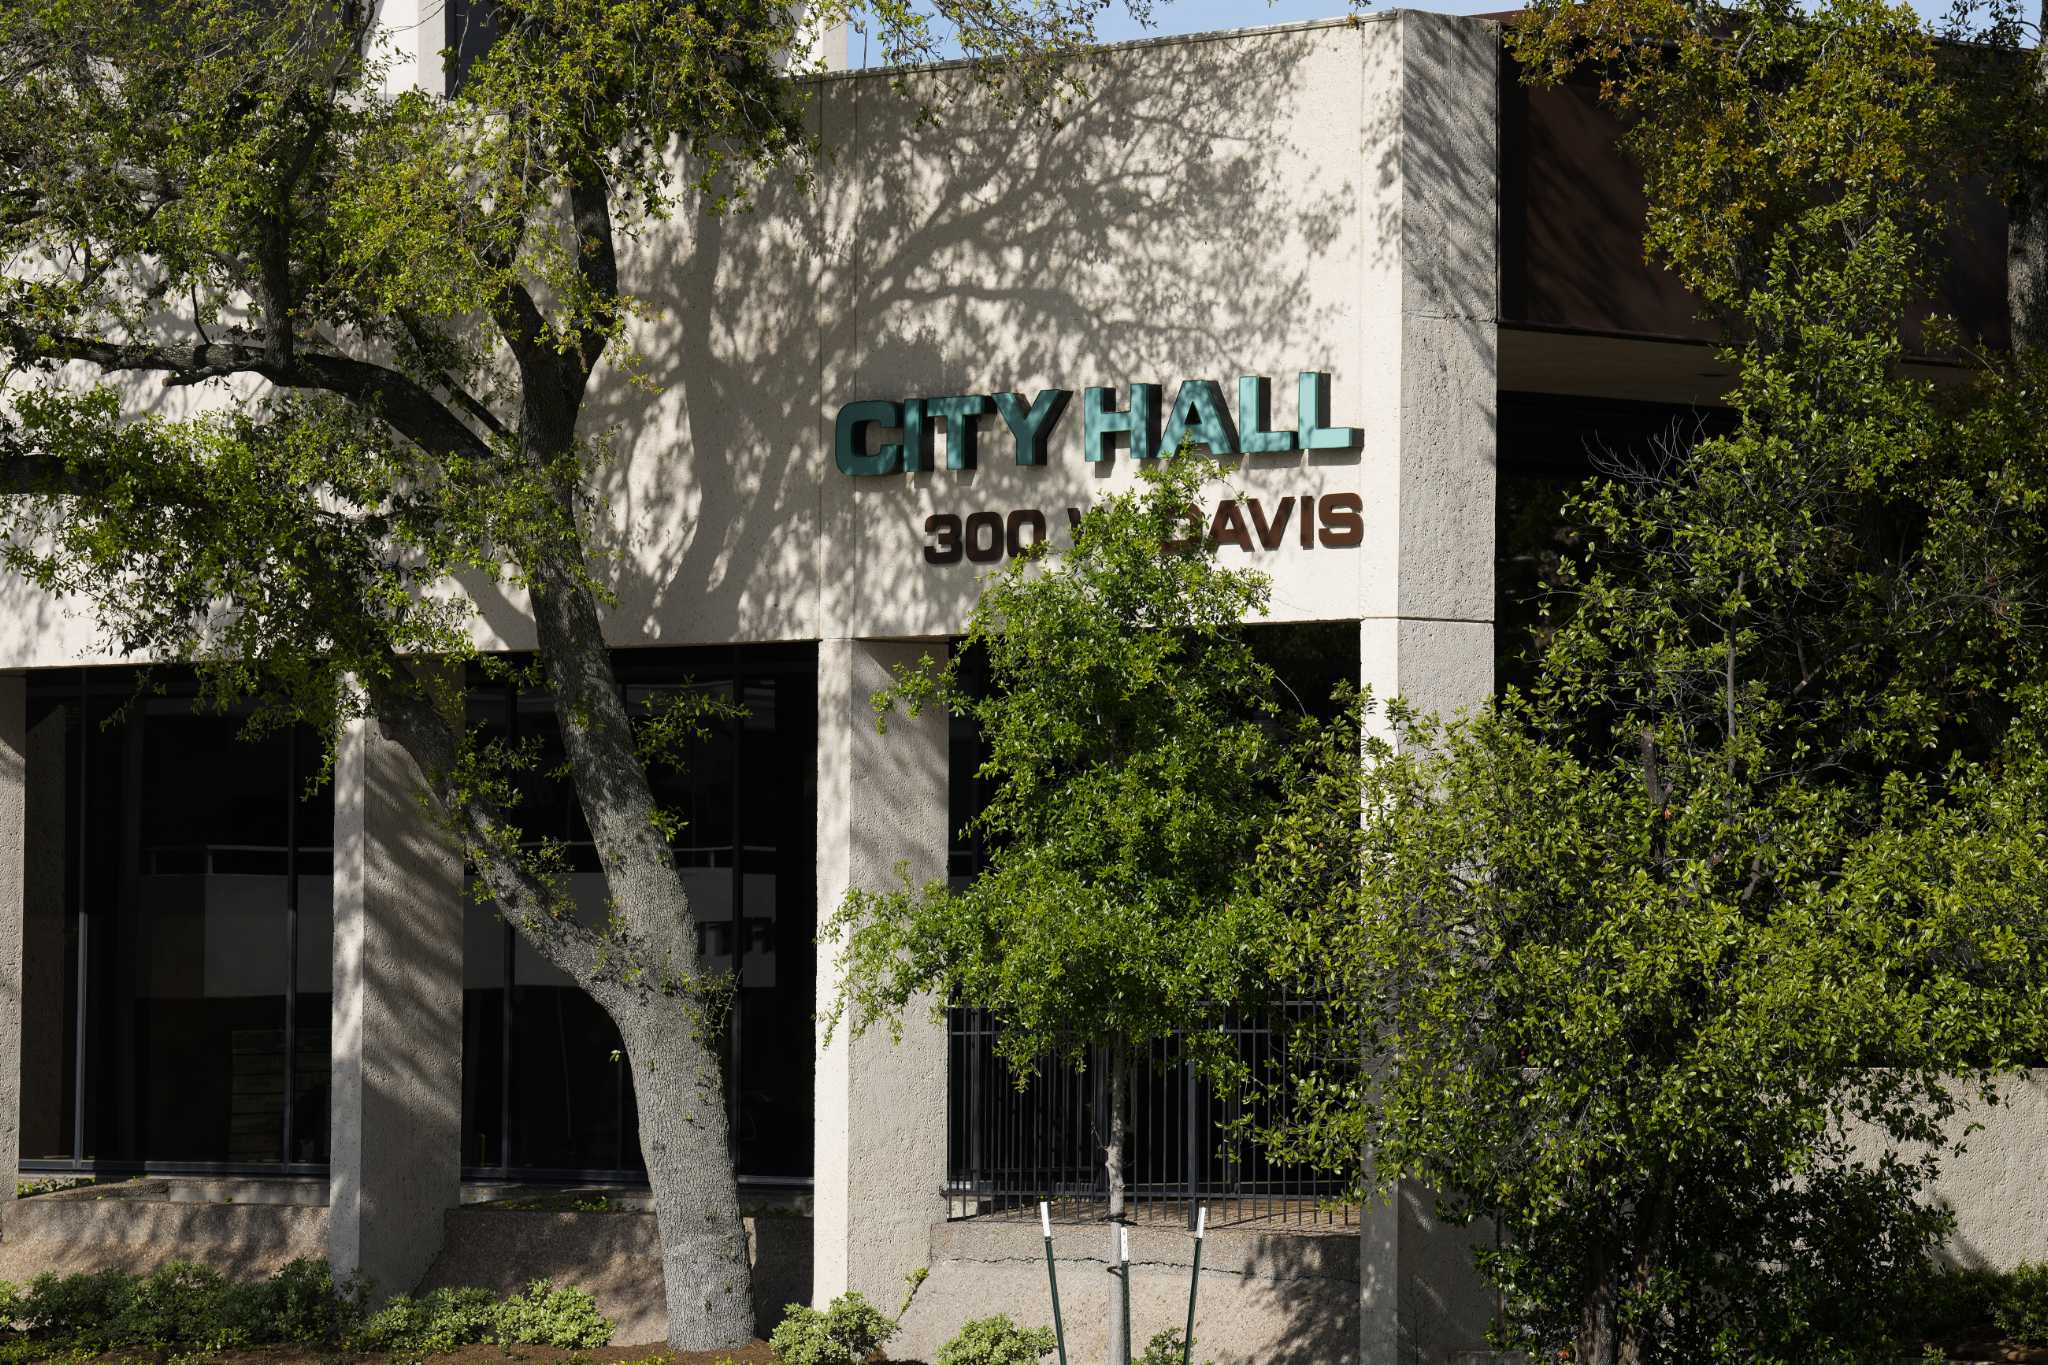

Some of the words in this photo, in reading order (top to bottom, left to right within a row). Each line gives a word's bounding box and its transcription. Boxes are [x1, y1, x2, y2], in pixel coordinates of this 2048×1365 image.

[835, 388, 1073, 476] CITY
[1084, 371, 1364, 462] HALL
[924, 508, 1047, 565] 300
